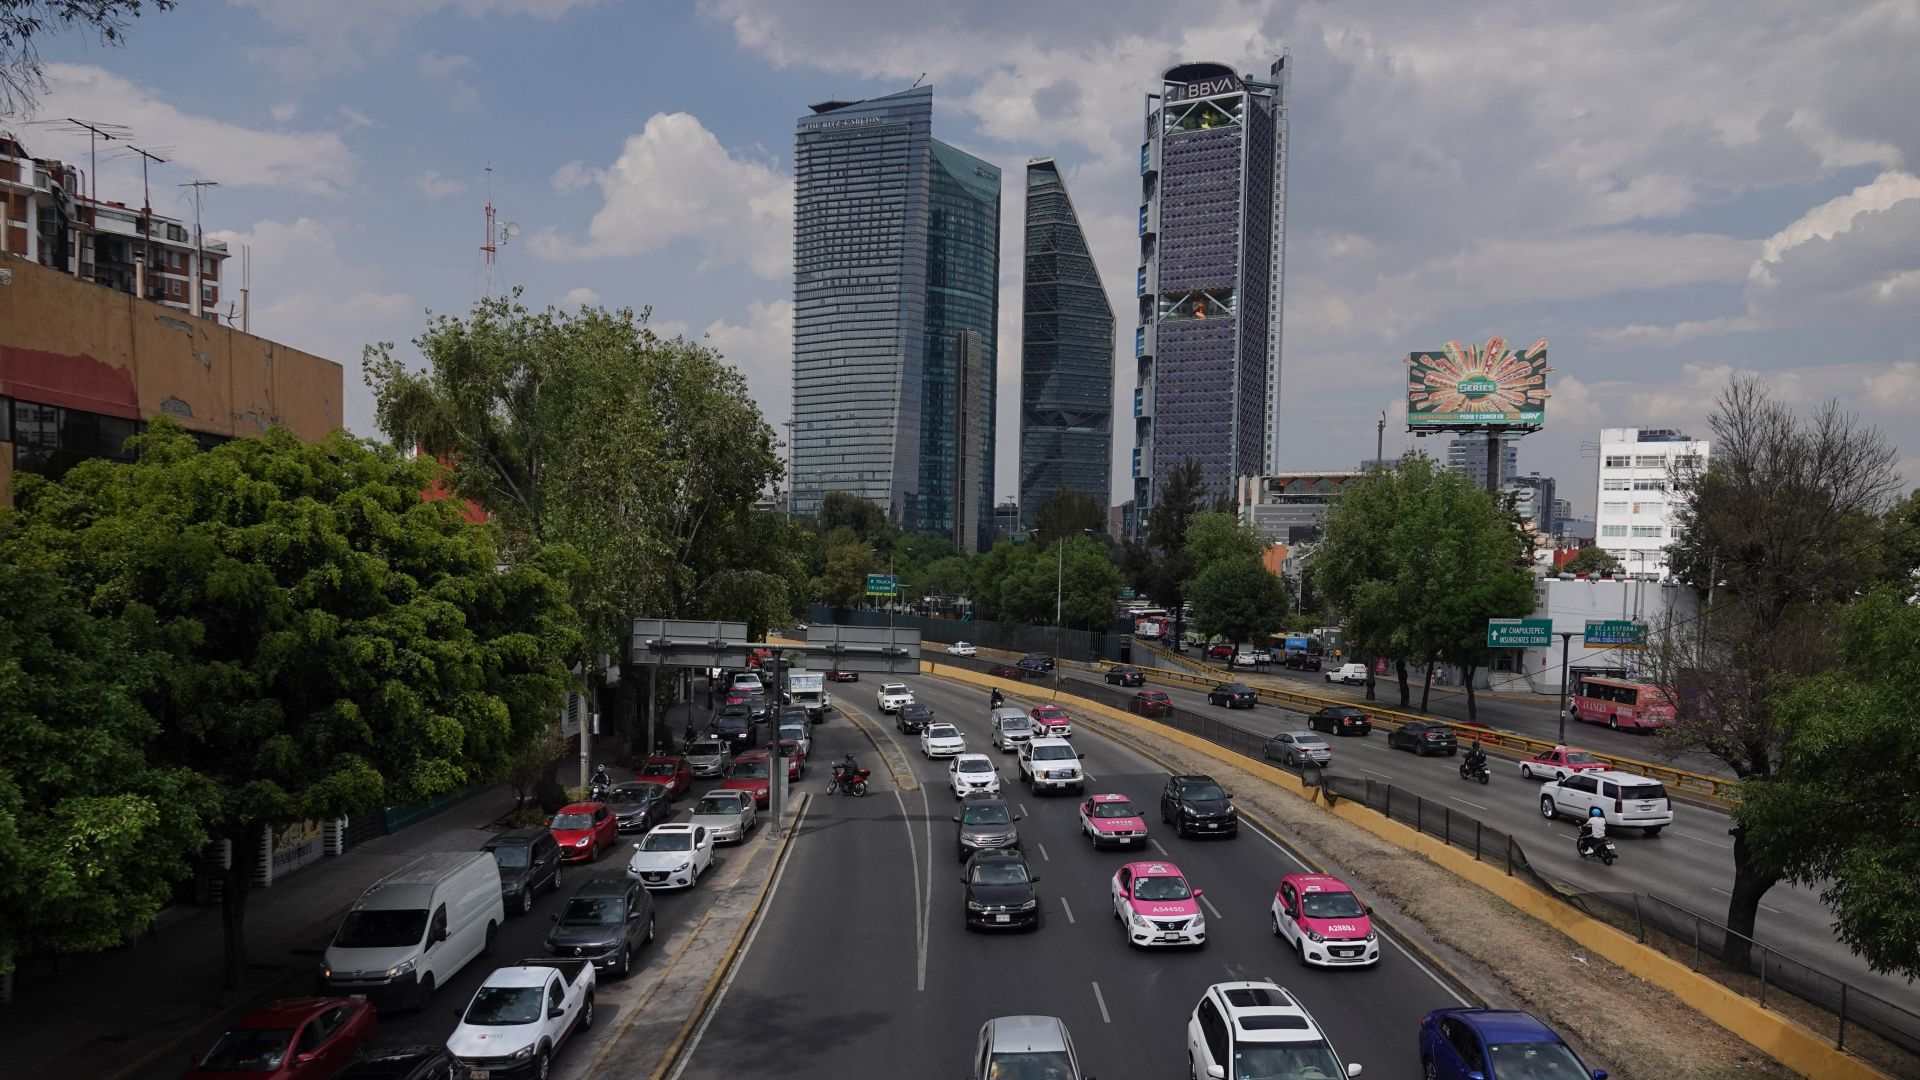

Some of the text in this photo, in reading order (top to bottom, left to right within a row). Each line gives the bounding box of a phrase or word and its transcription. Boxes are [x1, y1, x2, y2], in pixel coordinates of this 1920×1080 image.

[1188, 78, 1233, 98] BBVA
[1459, 383, 1495, 393] SERIES
[1508, 627, 1545, 635] CHAPULTEPEC
